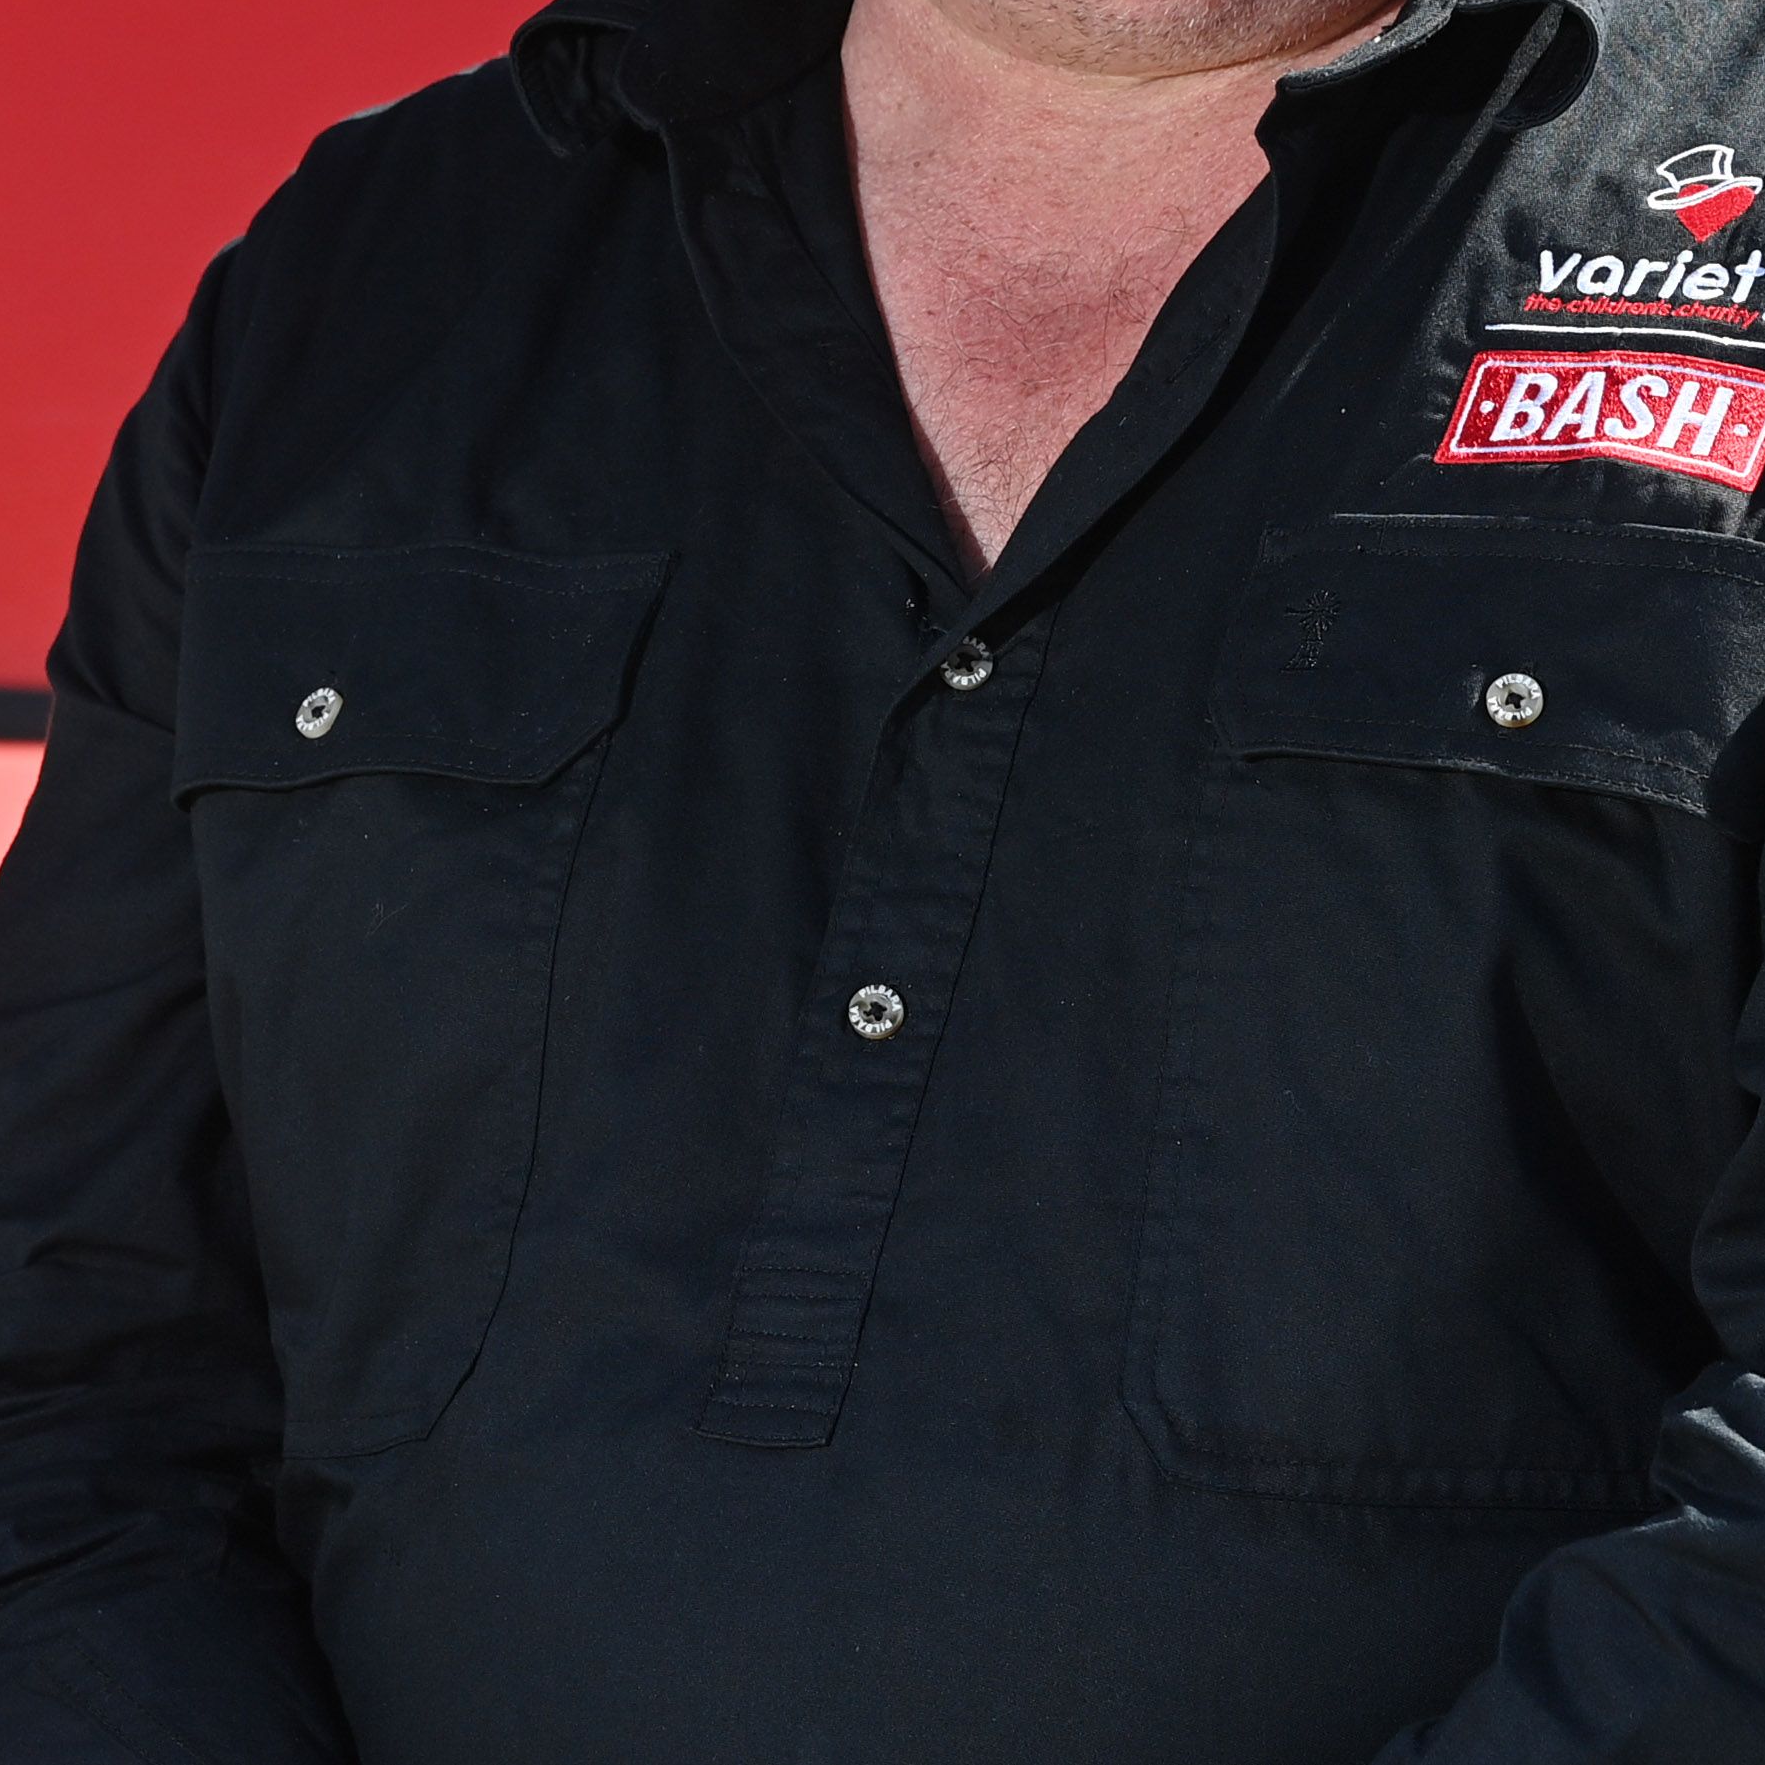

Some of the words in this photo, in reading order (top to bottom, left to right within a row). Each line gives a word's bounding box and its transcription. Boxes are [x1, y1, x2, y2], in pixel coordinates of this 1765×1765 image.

[1524, 293, 1561, 313] the
[1672, 300, 1760, 330] charity
[940, 661, 987, 686] PILBARA
[1496, 674, 1541, 700] PILBARA
[1487, 696, 1533, 721] PILBARA
[858, 984, 902, 1012] PILBARA
[848, 1005, 893, 1033] PILBARA
